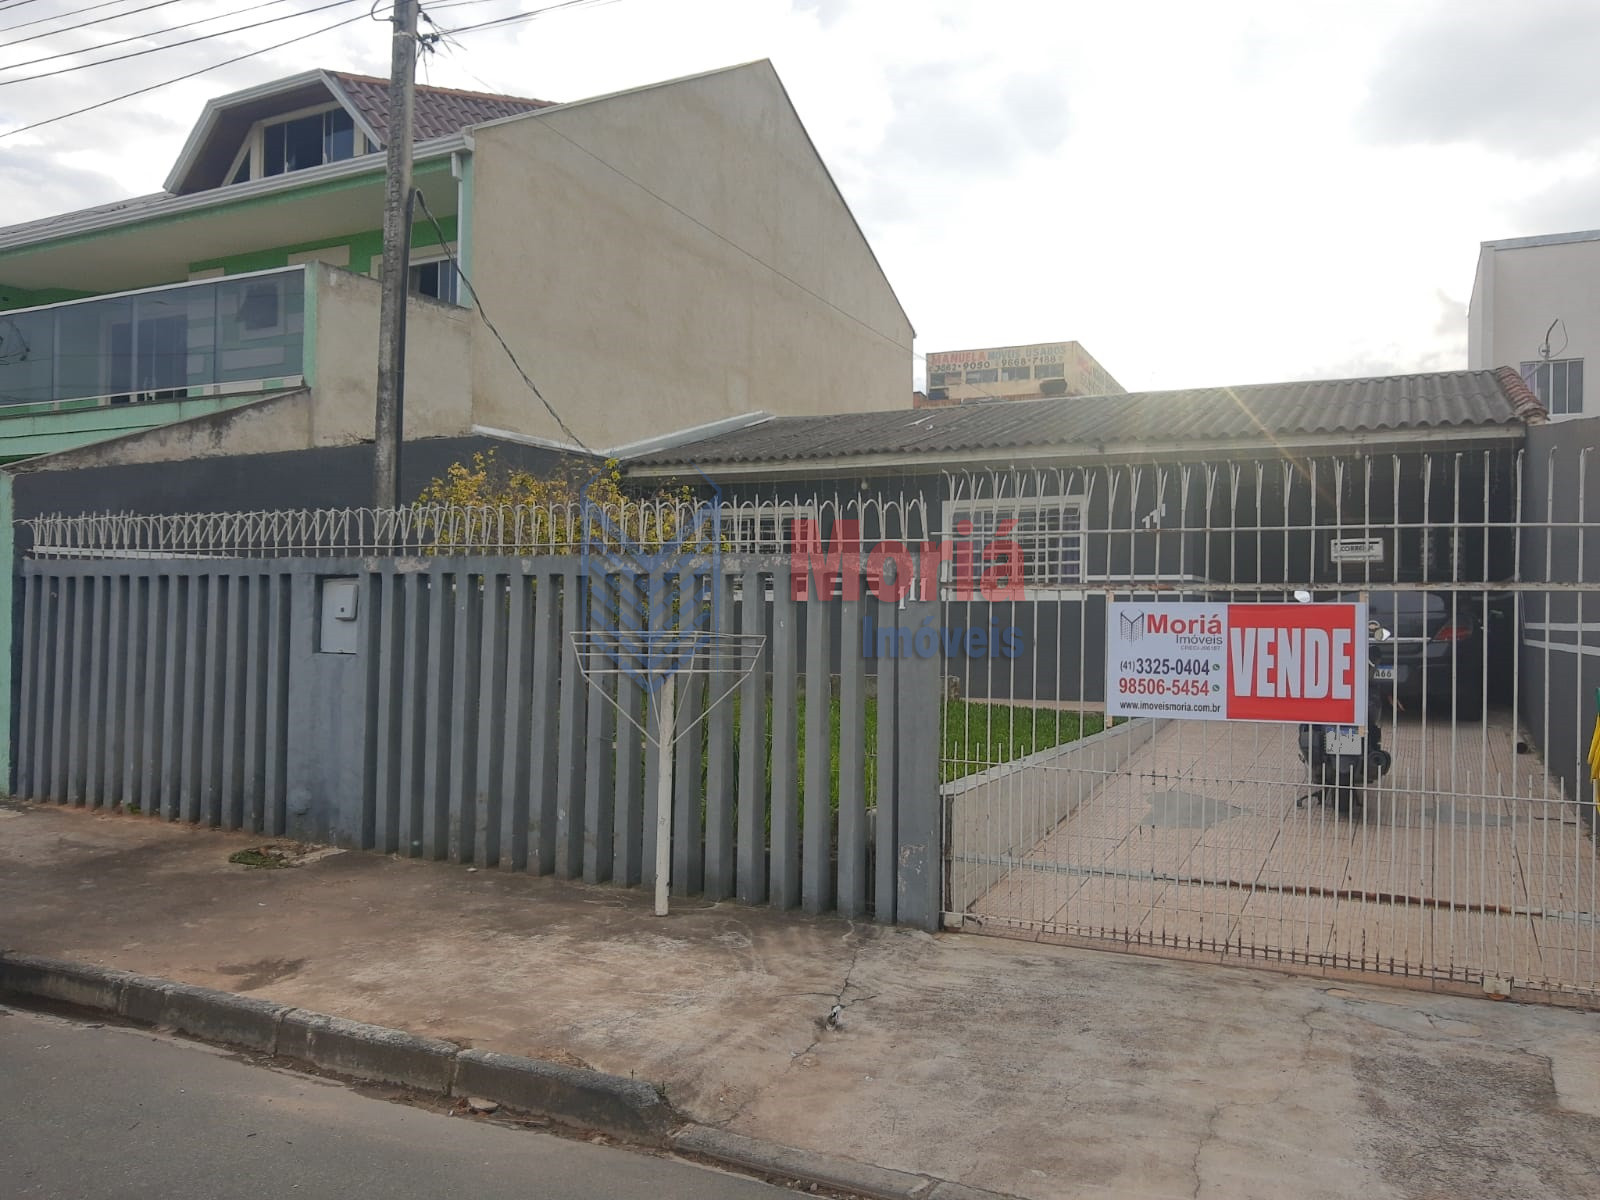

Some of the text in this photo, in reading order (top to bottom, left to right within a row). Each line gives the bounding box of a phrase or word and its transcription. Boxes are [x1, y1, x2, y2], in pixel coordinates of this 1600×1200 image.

[1147, 613, 1222, 635] Moriá
[1176, 634, 1224, 645] Imóveis
[1229, 627, 1352, 700] VENDE
[1118, 677, 1210, 697] 98506-5454
[1119, 701, 1221, 713] www.imoveismoria.com.br
